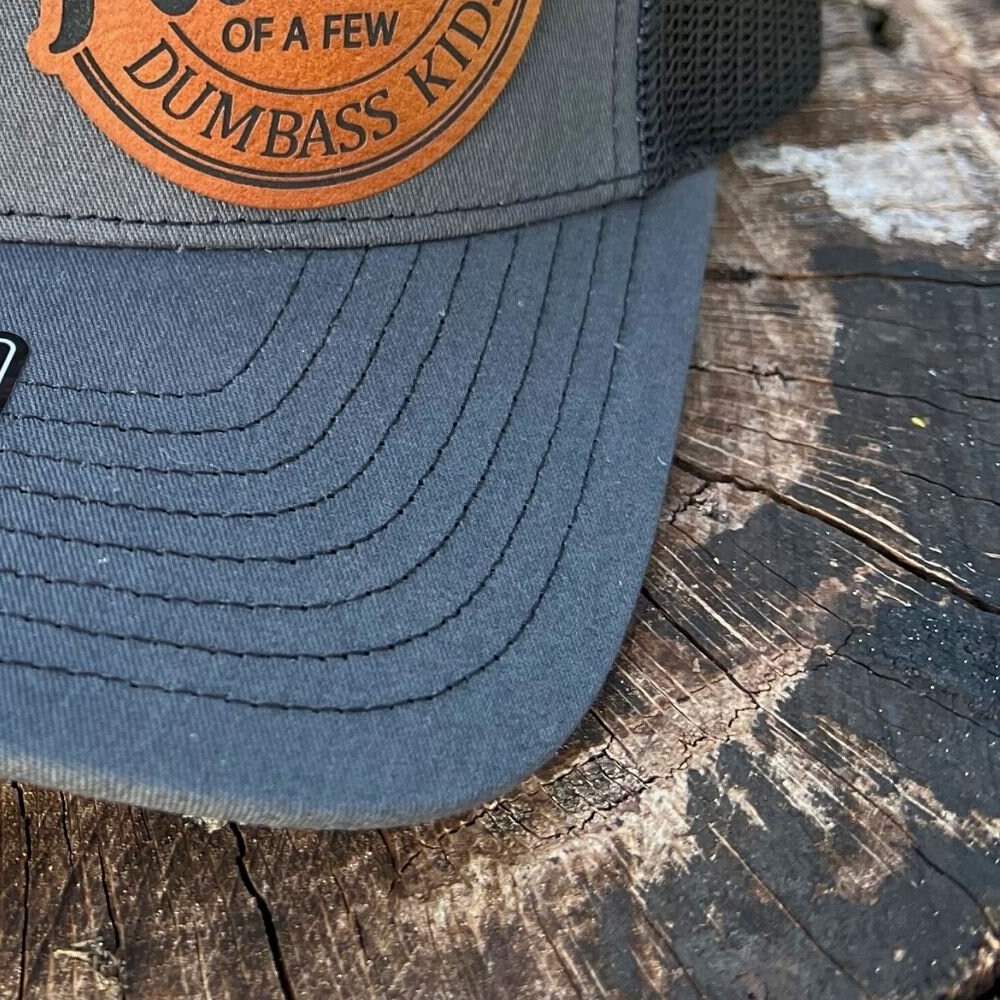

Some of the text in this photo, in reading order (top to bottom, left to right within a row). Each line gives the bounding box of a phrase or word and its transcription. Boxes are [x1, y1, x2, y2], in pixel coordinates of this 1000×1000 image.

[222, 11, 399, 53] OF A FEW
[123, 38, 399, 159] DUMBASS
